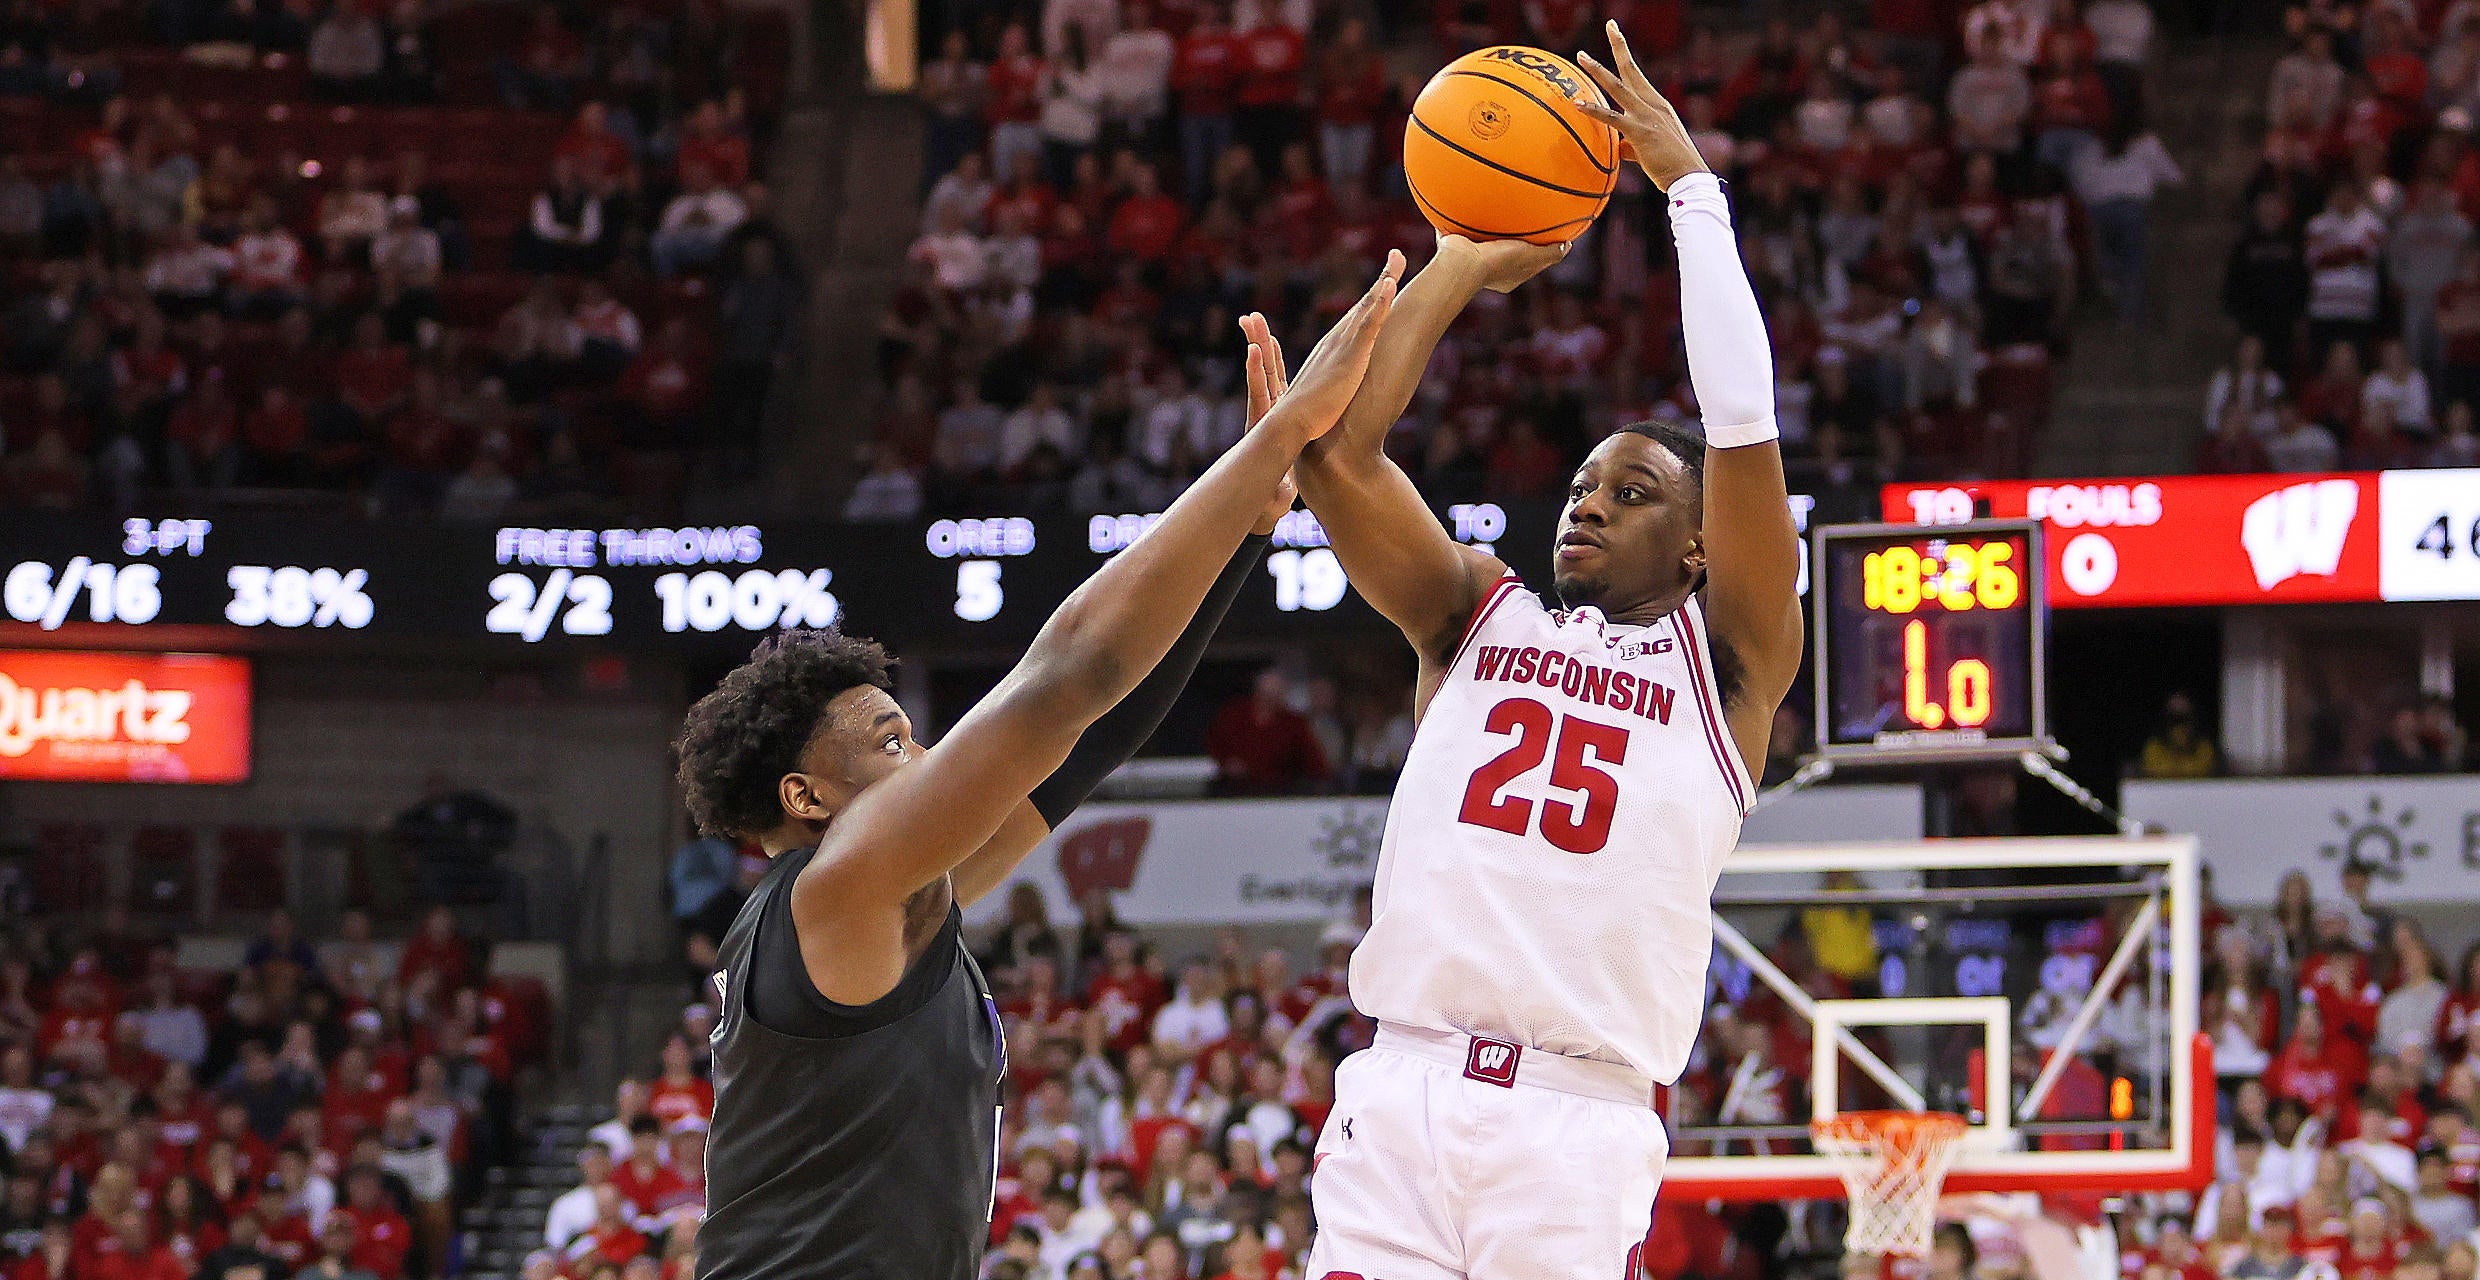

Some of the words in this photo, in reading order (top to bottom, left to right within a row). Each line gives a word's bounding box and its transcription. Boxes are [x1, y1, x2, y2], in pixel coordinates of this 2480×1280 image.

[1482, 48, 1579, 99] NCAA
[1447, 503, 1507, 542] TO
[1907, 487, 1974, 526] TO
[2027, 483, 2163, 527] FOULS
[123, 518, 212, 556] 3-PT
[496, 527, 598, 567] FREE
[600, 525, 763, 566] THROWS
[926, 517, 1036, 558] OREB
[2416, 513, 2480, 562] 4
[1267, 548, 1348, 611] 19
[1864, 542, 2018, 613] 18:26
[2061, 533, 2119, 596] 0
[4, 556, 162, 631] 6/16
[225, 565, 374, 629] 38%
[486, 568, 613, 642] 2/2
[654, 568, 838, 632] 100%
[954, 560, 1004, 622] 5
[1474, 645, 1676, 726] WISCONSIN
[1457, 697, 1631, 855] 25
[1479, 1045, 1511, 1070] W
